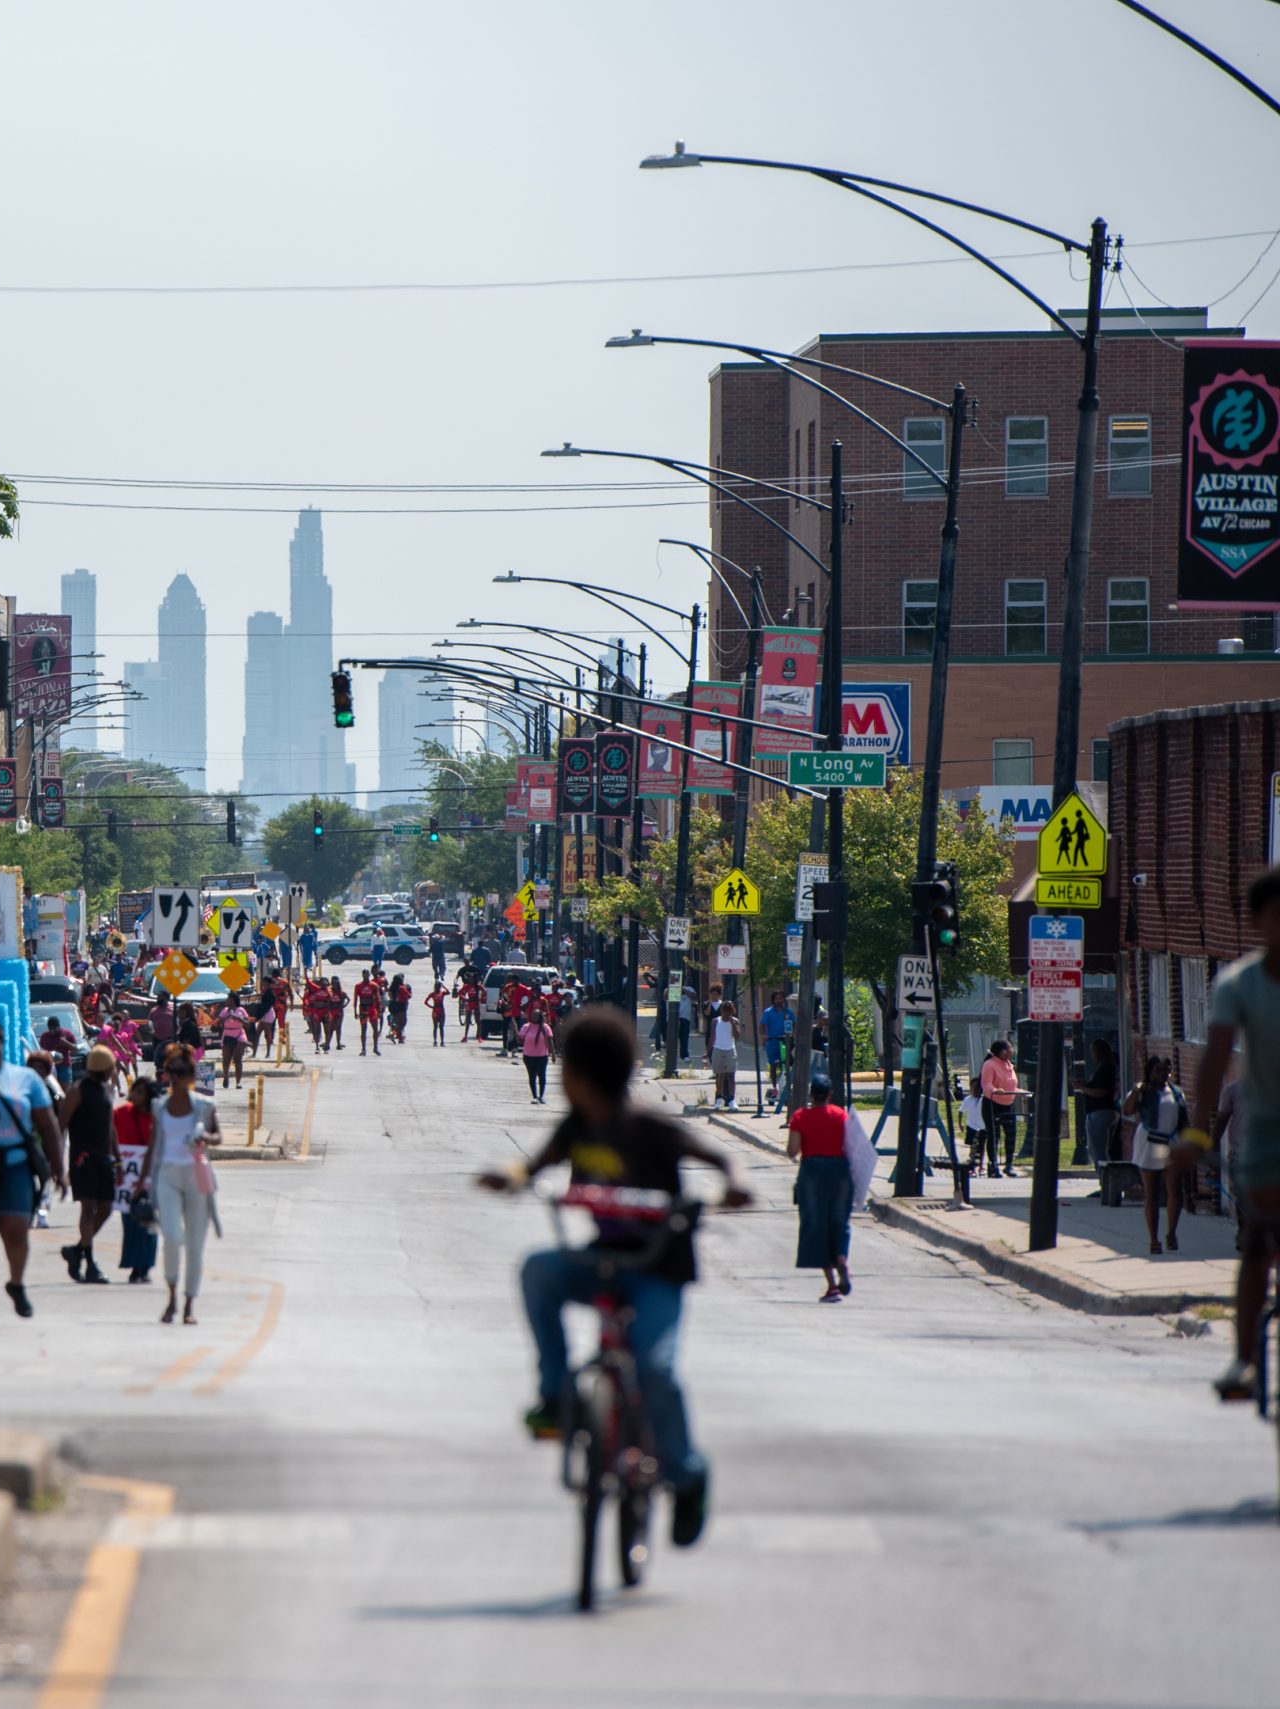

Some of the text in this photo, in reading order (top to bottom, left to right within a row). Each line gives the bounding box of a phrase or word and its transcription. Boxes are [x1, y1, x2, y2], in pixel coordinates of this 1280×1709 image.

[1195, 473, 1278, 497] AUSTIN
[1195, 496, 1278, 512] VILLAGE
[1201, 516, 1221, 529] AV
[1239, 519, 1271, 529] CHICAGO
[1220, 545, 1248, 560] SSA
[842, 704, 888, 735] M
[842, 737, 891, 747] ARATHON
[800, 756, 874, 774] N Long Av
[815, 773, 862, 782] 5400 W
[802, 867, 829, 876] SPEED
[1048, 885, 1091, 899] AHEAD
[669, 919, 688, 928] ONE
[668, 928, 687, 936] WAY
[1033, 971, 1064, 979] STREET
[903, 975, 934, 989] WAY
[1032, 979, 1077, 987] CLEANING
